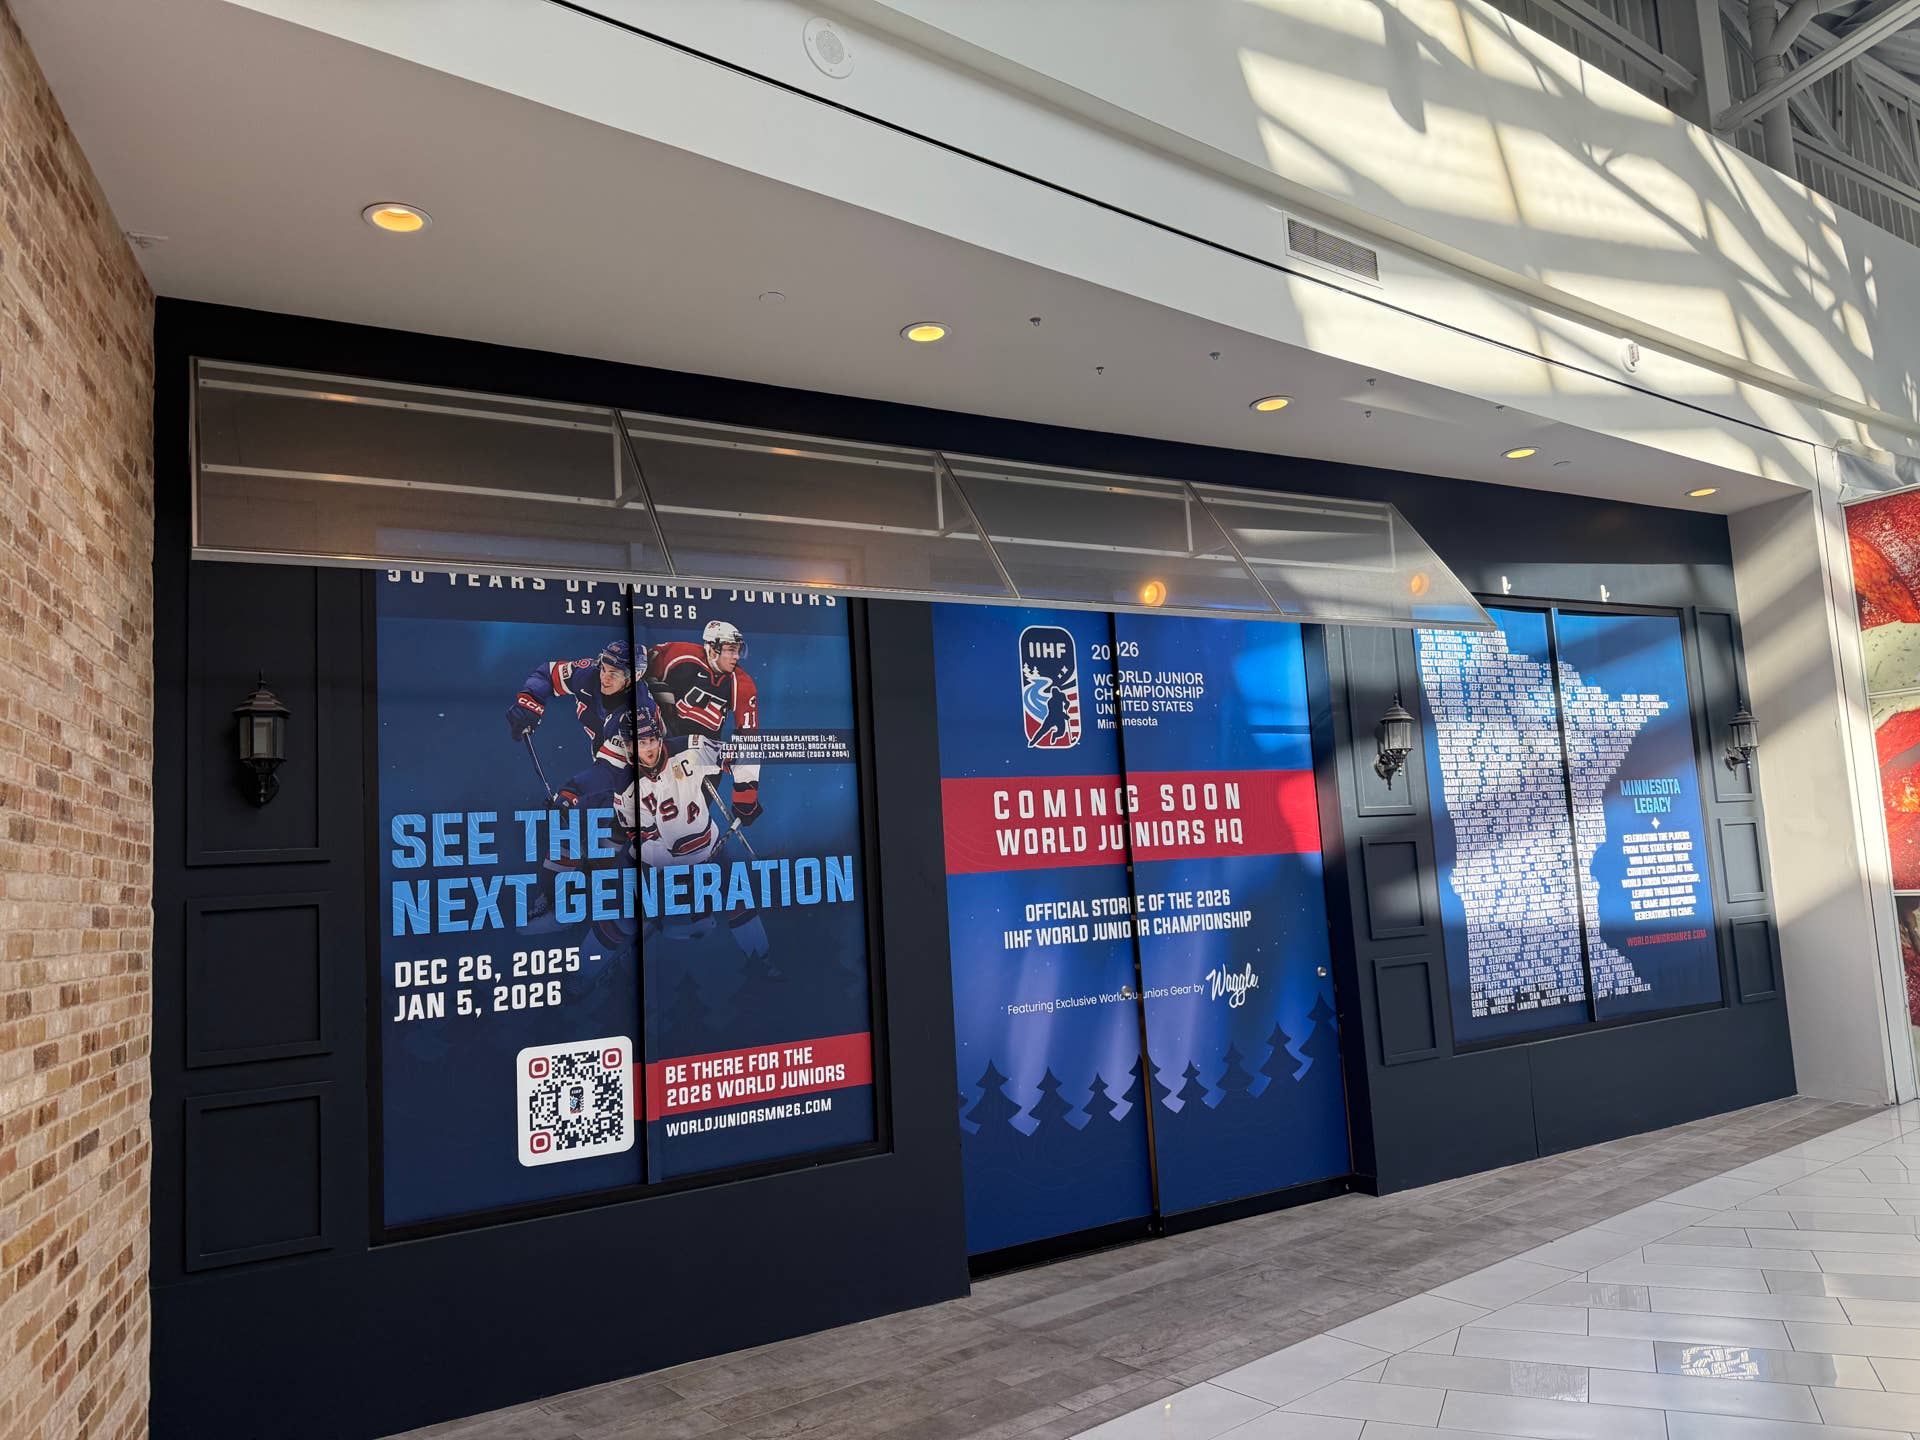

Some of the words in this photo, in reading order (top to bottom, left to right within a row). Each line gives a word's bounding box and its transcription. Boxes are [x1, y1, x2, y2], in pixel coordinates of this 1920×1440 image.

[1029, 642, 1066, 658] IIHF
[1092, 642, 1139, 660] 2026
[1093, 670, 1151, 687] WORLD
[1155, 672, 1203, 685] JUNIOR
[1094, 685, 1203, 700] CHAMPIONSHIP
[518, 697, 544, 716] CCM
[1096, 700, 1149, 715] UNITED
[1152, 701, 1193, 712] STATES
[1098, 717, 1158, 729] Minnesota
[993, 787, 1139, 820] COMING
[1161, 782, 1241, 812] SOON
[1620, 778, 1681, 796] MINNESOTA
[1634, 797, 1672, 814] LEGACY
[391, 811, 498, 869] SEE
[515, 807, 615, 863] THE
[996, 826, 1086, 856] WORLD
[1098, 819, 1206, 851] JUNIORS
[1215, 818, 1243, 845] HQ
[391, 873, 537, 936] NEXT
[554, 855, 855, 925] GENERATION
[1025, 900, 1088, 922] OFFICIAL
[1148, 894, 1165, 911] OF
[1168, 892, 1193, 909] THE
[1196, 889, 1231, 908] 2026
[1004, 929, 1032, 950] IIHF
[1036, 923, 1088, 947] WORLD
[1153, 911, 1252, 936] CHAMPIONSHIP
[394, 959, 447, 988] DEC
[458, 955, 501, 983] 26,
[513, 947, 581, 977] 2025
[1206, 962, 1258, 1009] Waggle
[393, 992, 444, 1023] JAN
[456, 989, 482, 1018] 5,
[493, 981, 562, 1011] 2026
[1007, 999, 1053, 1016] Featuring
[1056, 995, 1097, 1010] Exclusive
[1171, 984, 1192, 997] Gear
[1193, 982, 1205, 995] by
[665, 1066, 686, 1084] BE
[691, 1056, 743, 1081] THERE
[749, 1051, 779, 1072] FOR
[784, 1046, 813, 1068] THE
[666, 1085, 711, 1107] 2026
[717, 1074, 776, 1100] WORLD
[780, 1064, 845, 1091] JUNIORS
[666, 1098, 832, 1137] WORLDJUNIORSMN26.COM
